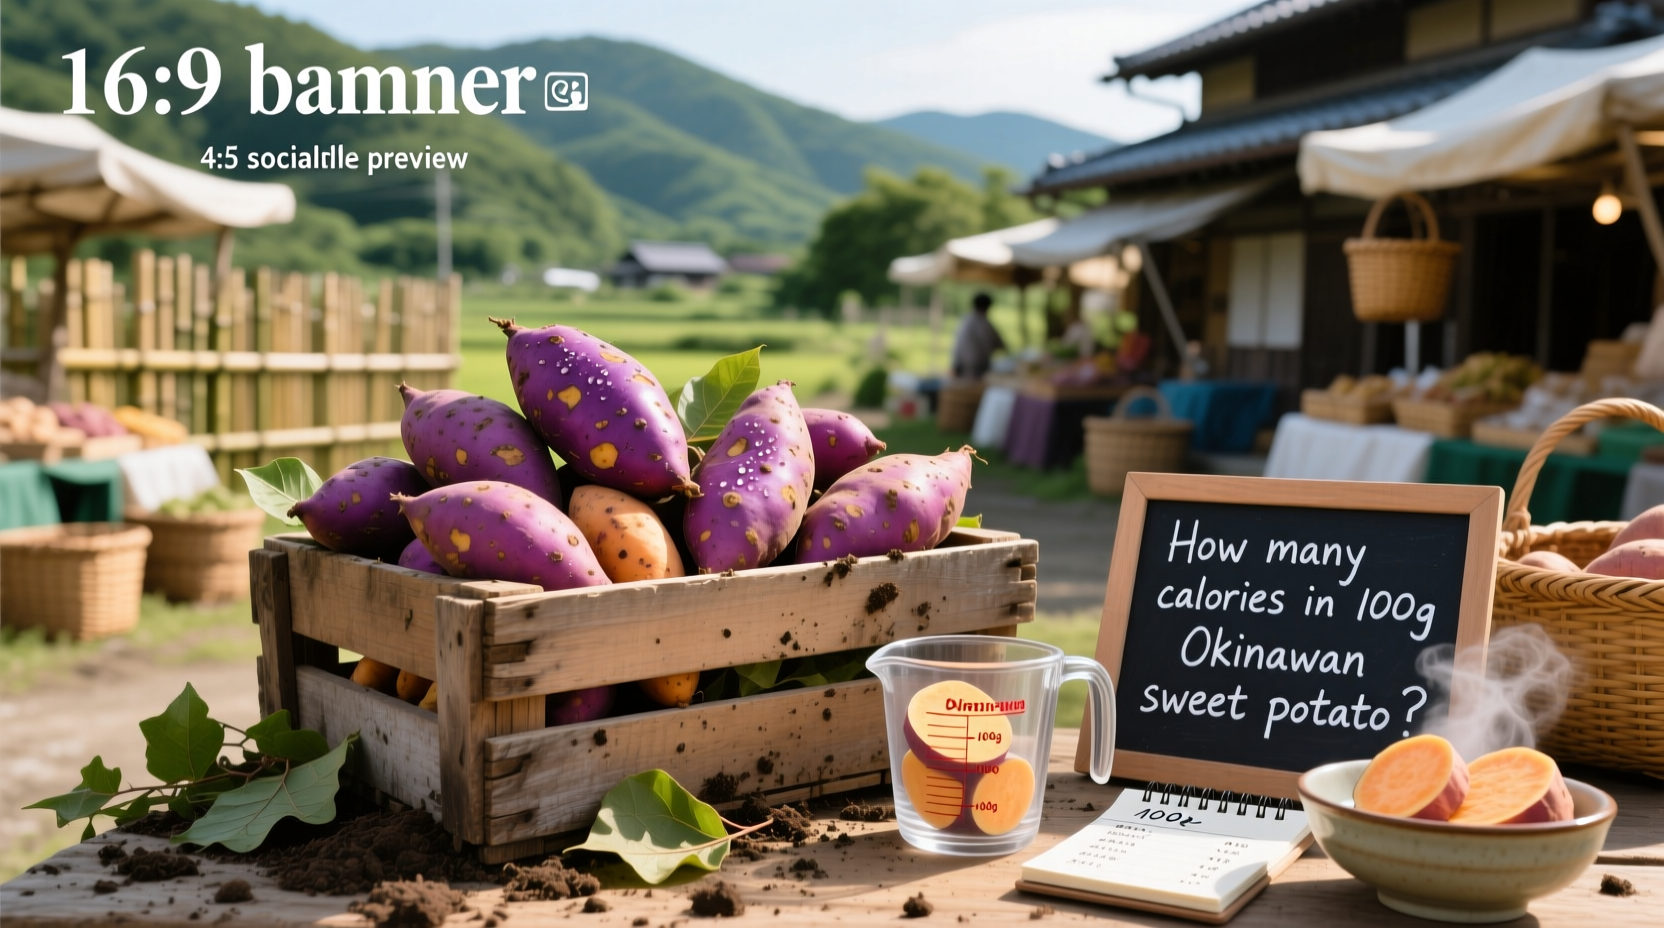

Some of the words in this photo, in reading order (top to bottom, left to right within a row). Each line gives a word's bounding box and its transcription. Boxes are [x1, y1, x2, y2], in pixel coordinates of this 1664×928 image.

[1167, 519, 1248, 564] How
[1265, 539, 1367, 588] many
[1157, 575, 1285, 615] calories
[1304, 585, 1334, 618] in
[1356, 587, 1436, 642] 100g
[1180, 625, 1364, 678] Okinawan
[1139, 684, 1248, 721] sweet
